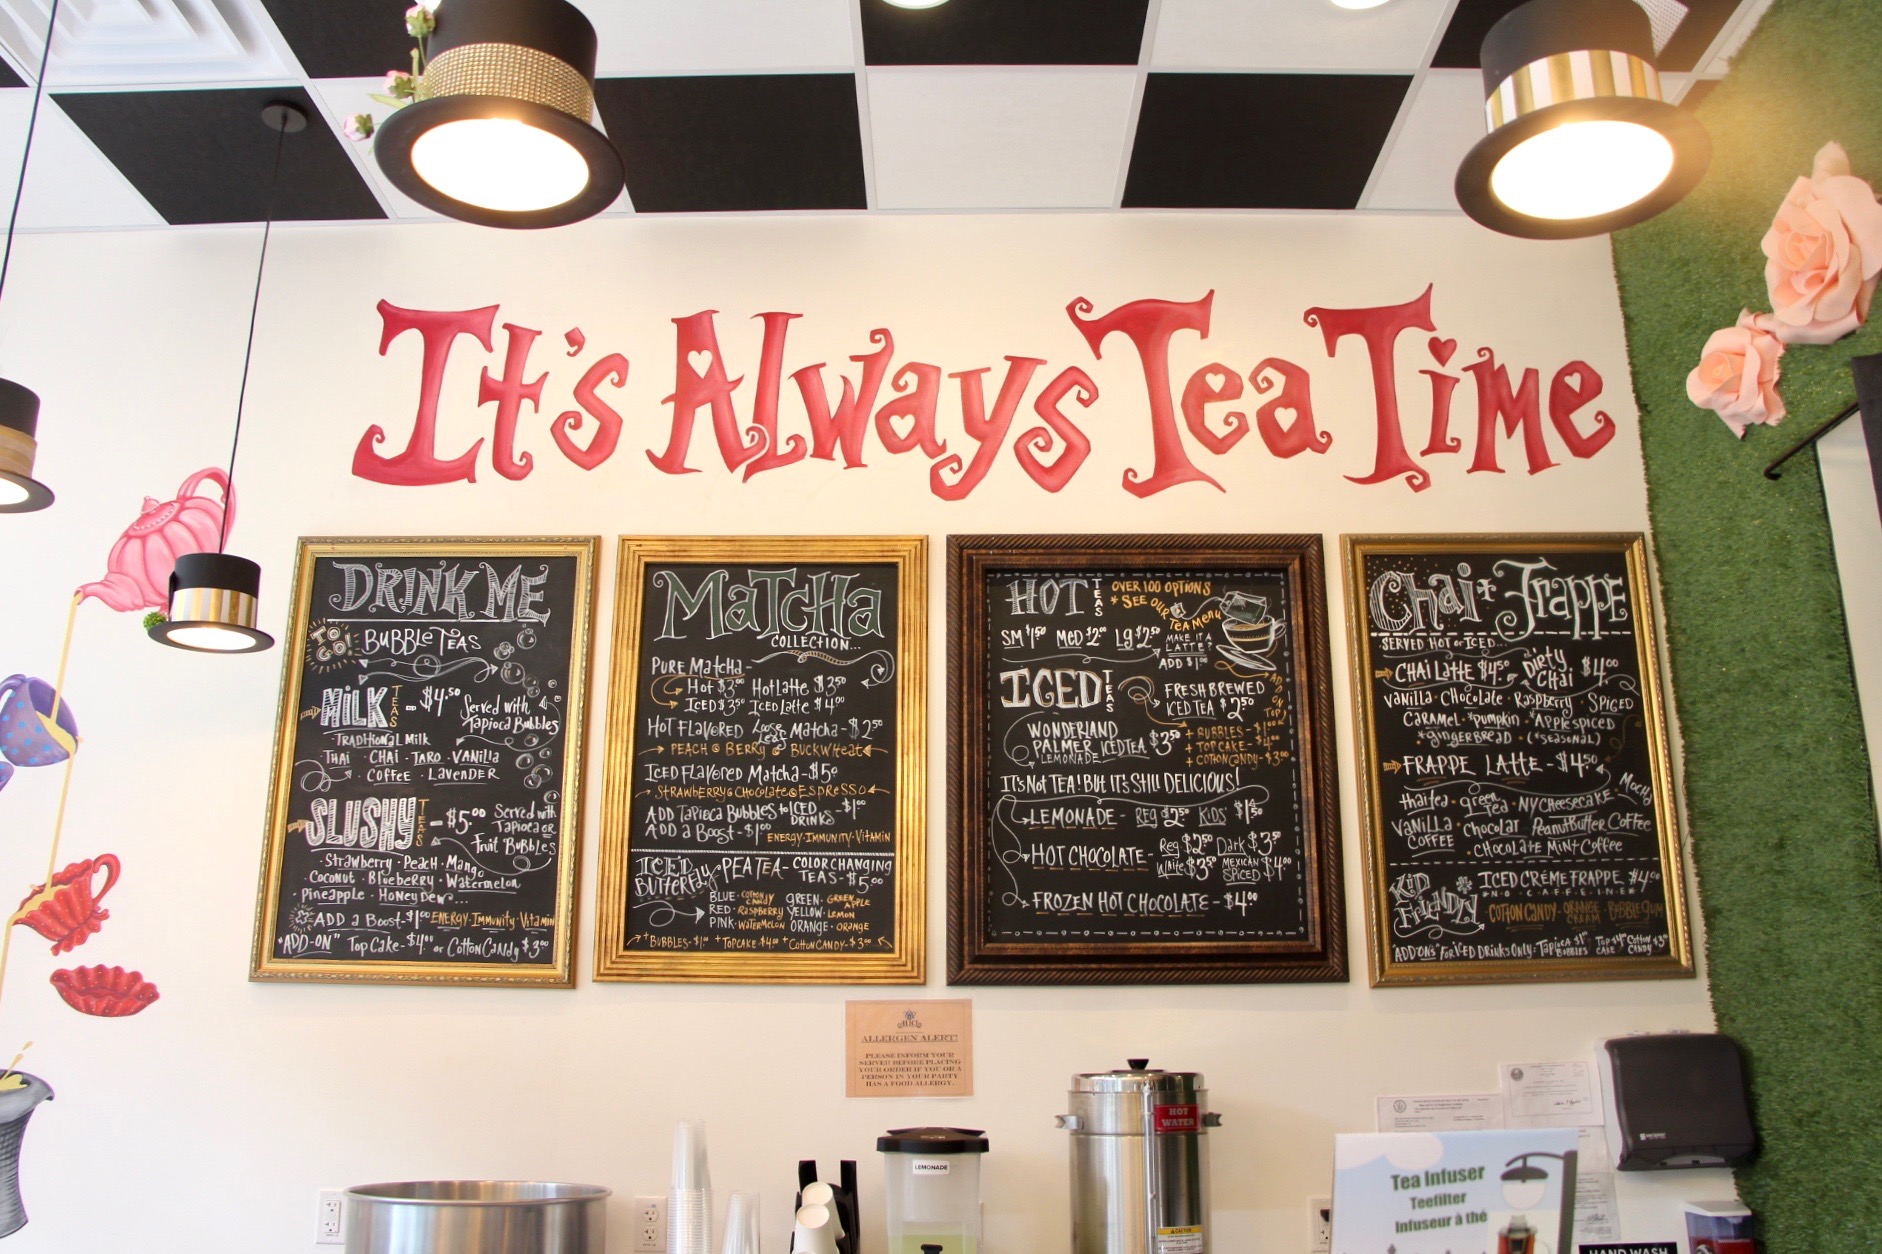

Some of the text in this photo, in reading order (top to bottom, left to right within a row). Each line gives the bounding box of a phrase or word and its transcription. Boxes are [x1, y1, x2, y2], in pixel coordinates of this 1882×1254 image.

[352, 298, 629, 487] It's
[1066, 289, 1332, 499] Tea
[1303, 282, 1616, 492] Time
[329, 560, 550, 627] DRINK ME
[1112, 580, 1161, 593] OVER 100
[1006, 579, 1088, 615] HOT
[1092, 578, 1102, 617] TEAS
[1122, 595, 1148, 608] SEE
[311, 626, 340, 645] TO
[431, 627, 481, 655] TEAS
[1001, 630, 1023, 646] SM
[1166, 634, 1192, 642] MAKE
[1382, 637, 1424, 650] SERVED
[1429, 638, 1450, 649] HOT
[651, 657, 685, 675] PURE
[1159, 658, 1182, 669] ADD
[687, 678, 714, 695] Hot
[1000, 668, 1102, 708] ICED
[1102, 670, 1114, 713] TEAS
[1165, 681, 1265, 698] FRESH BREWED
[390, 685, 402, 728] TEAS
[420, 686, 460, 717] $4.50
[460, 694, 531, 719] Served with
[1166, 701, 1190, 716] ICED
[1194, 700, 1214, 716] TEA
[462, 715, 559, 734] Tapioca Bubbles
[790, 720, 837, 738] Matcha
[1027, 721, 1118, 738] WONDERLAND
[411, 752, 441, 763] TARO
[671, 743, 708, 755] PEACH
[1032, 740, 1092, 758] PALMER
[1040, 752, 1100, 764] LEMONADE
[1403, 755, 1475, 776] FRAPPE
[494, 801, 556, 819] Served with
[1029, 808, 1118, 826] LEMONADE
[305, 797, 416, 851] SLUSHY
[416, 799, 430, 847] TEAS
[447, 807, 487, 834] $5.00
[646, 824, 677, 839] ADD
[1031, 844, 1065, 866] HOT
[722, 858, 828, 883] PEA TEA COLOR
[799, 871, 837, 884] TEAS
[1478, 871, 1517, 888] ICED
[1569, 871, 1624, 886] FRAPPE
[710, 892, 735, 902] BLUE
[1032, 892, 1093, 909] FROZEN
[1099, 891, 1123, 912] HOT
[313, 912, 345, 927] ADD
[709, 905, 822, 918] RED YELLOW
[710, 917, 734, 929] PINK
[1168, 1107, 1189, 1116] HOT
[1161, 1118, 1195, 1127] WATER
[1391, 1166, 1485, 1191] Tea Infuser
[1410, 1193, 1467, 1210] Teefilter
[1395, 1209, 1487, 1234] Infuseur à thé
